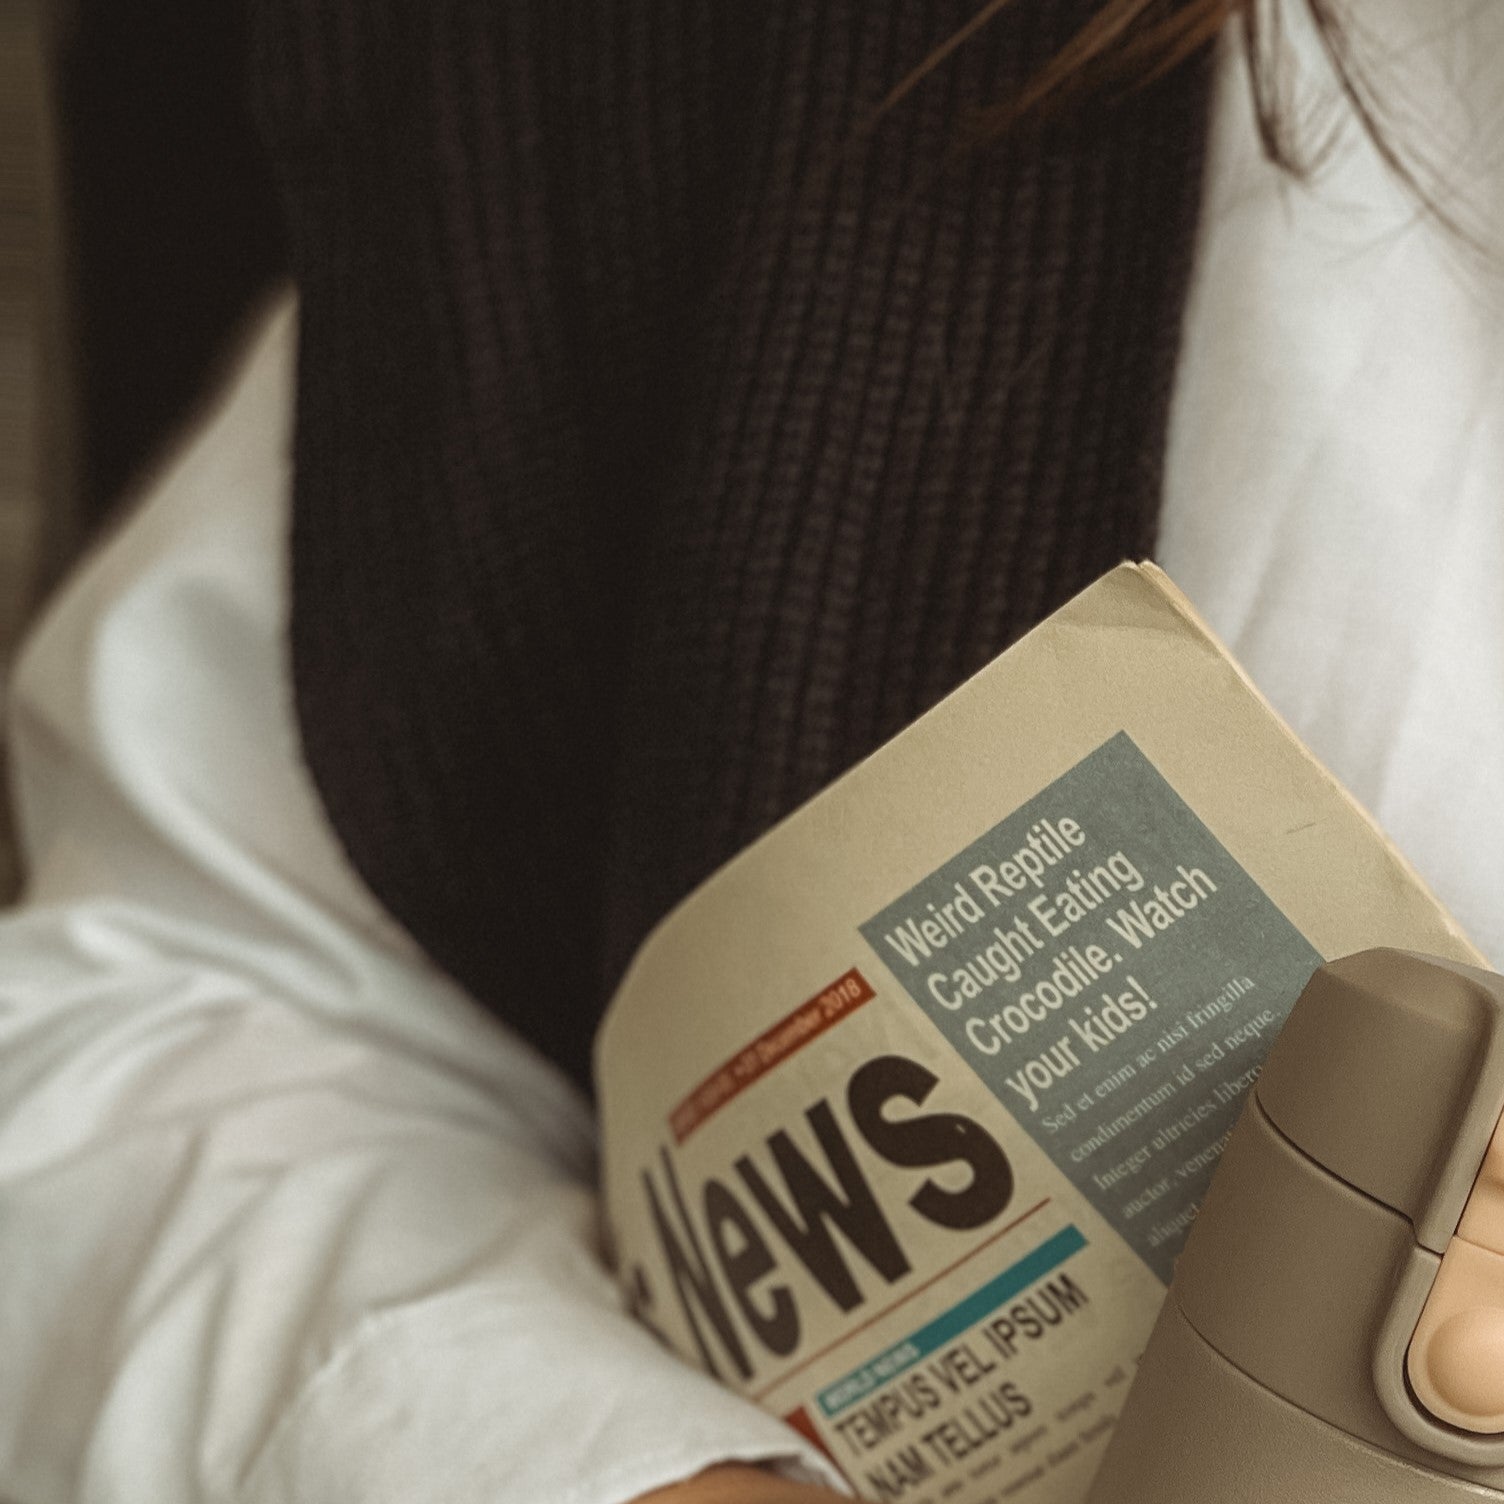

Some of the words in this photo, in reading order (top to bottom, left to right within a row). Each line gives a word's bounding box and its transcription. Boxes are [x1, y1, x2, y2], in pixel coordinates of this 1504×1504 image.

[884, 883, 985, 966] Weird
[969, 817, 1086, 906] Reptile
[928, 916, 1044, 1010] Caught
[1028, 851, 1144, 936] Eating
[966, 944, 1123, 1055] Crocodile.
[1106, 865, 1217, 949] Watch
[820, 978, 861, 1018] 2018
[1005, 1035, 1081, 1112] your
[1068, 975, 1157, 1051] kids!
[1042, 1102, 1077, 1134] Sed
[1077, 1093, 1095, 1111] et
[1095, 1063, 1137, 1098] enim
[1137, 1049, 1156, 1069] ac
[1157, 1020, 1189, 1052] nisi
[1187, 976, 1255, 1028] fringilla
[1070, 1082, 1177, 1163] condimentum
[1177, 1065, 1196, 1086] id
[1195, 1043, 1225, 1071] sed
[1093, 1145, 1152, 1192] Integer
[1151, 1101, 1217, 1151] ultricies
[642, 1053, 1014, 1383] News
[835, 1372, 941, 1455] TEMPUS
[927, 1343, 997, 1394] VEL
[983, 1272, 1089, 1360] IPSUM
[866, 1445, 934, 1499] NAM
[921, 1381, 1034, 1467] TELLUS
